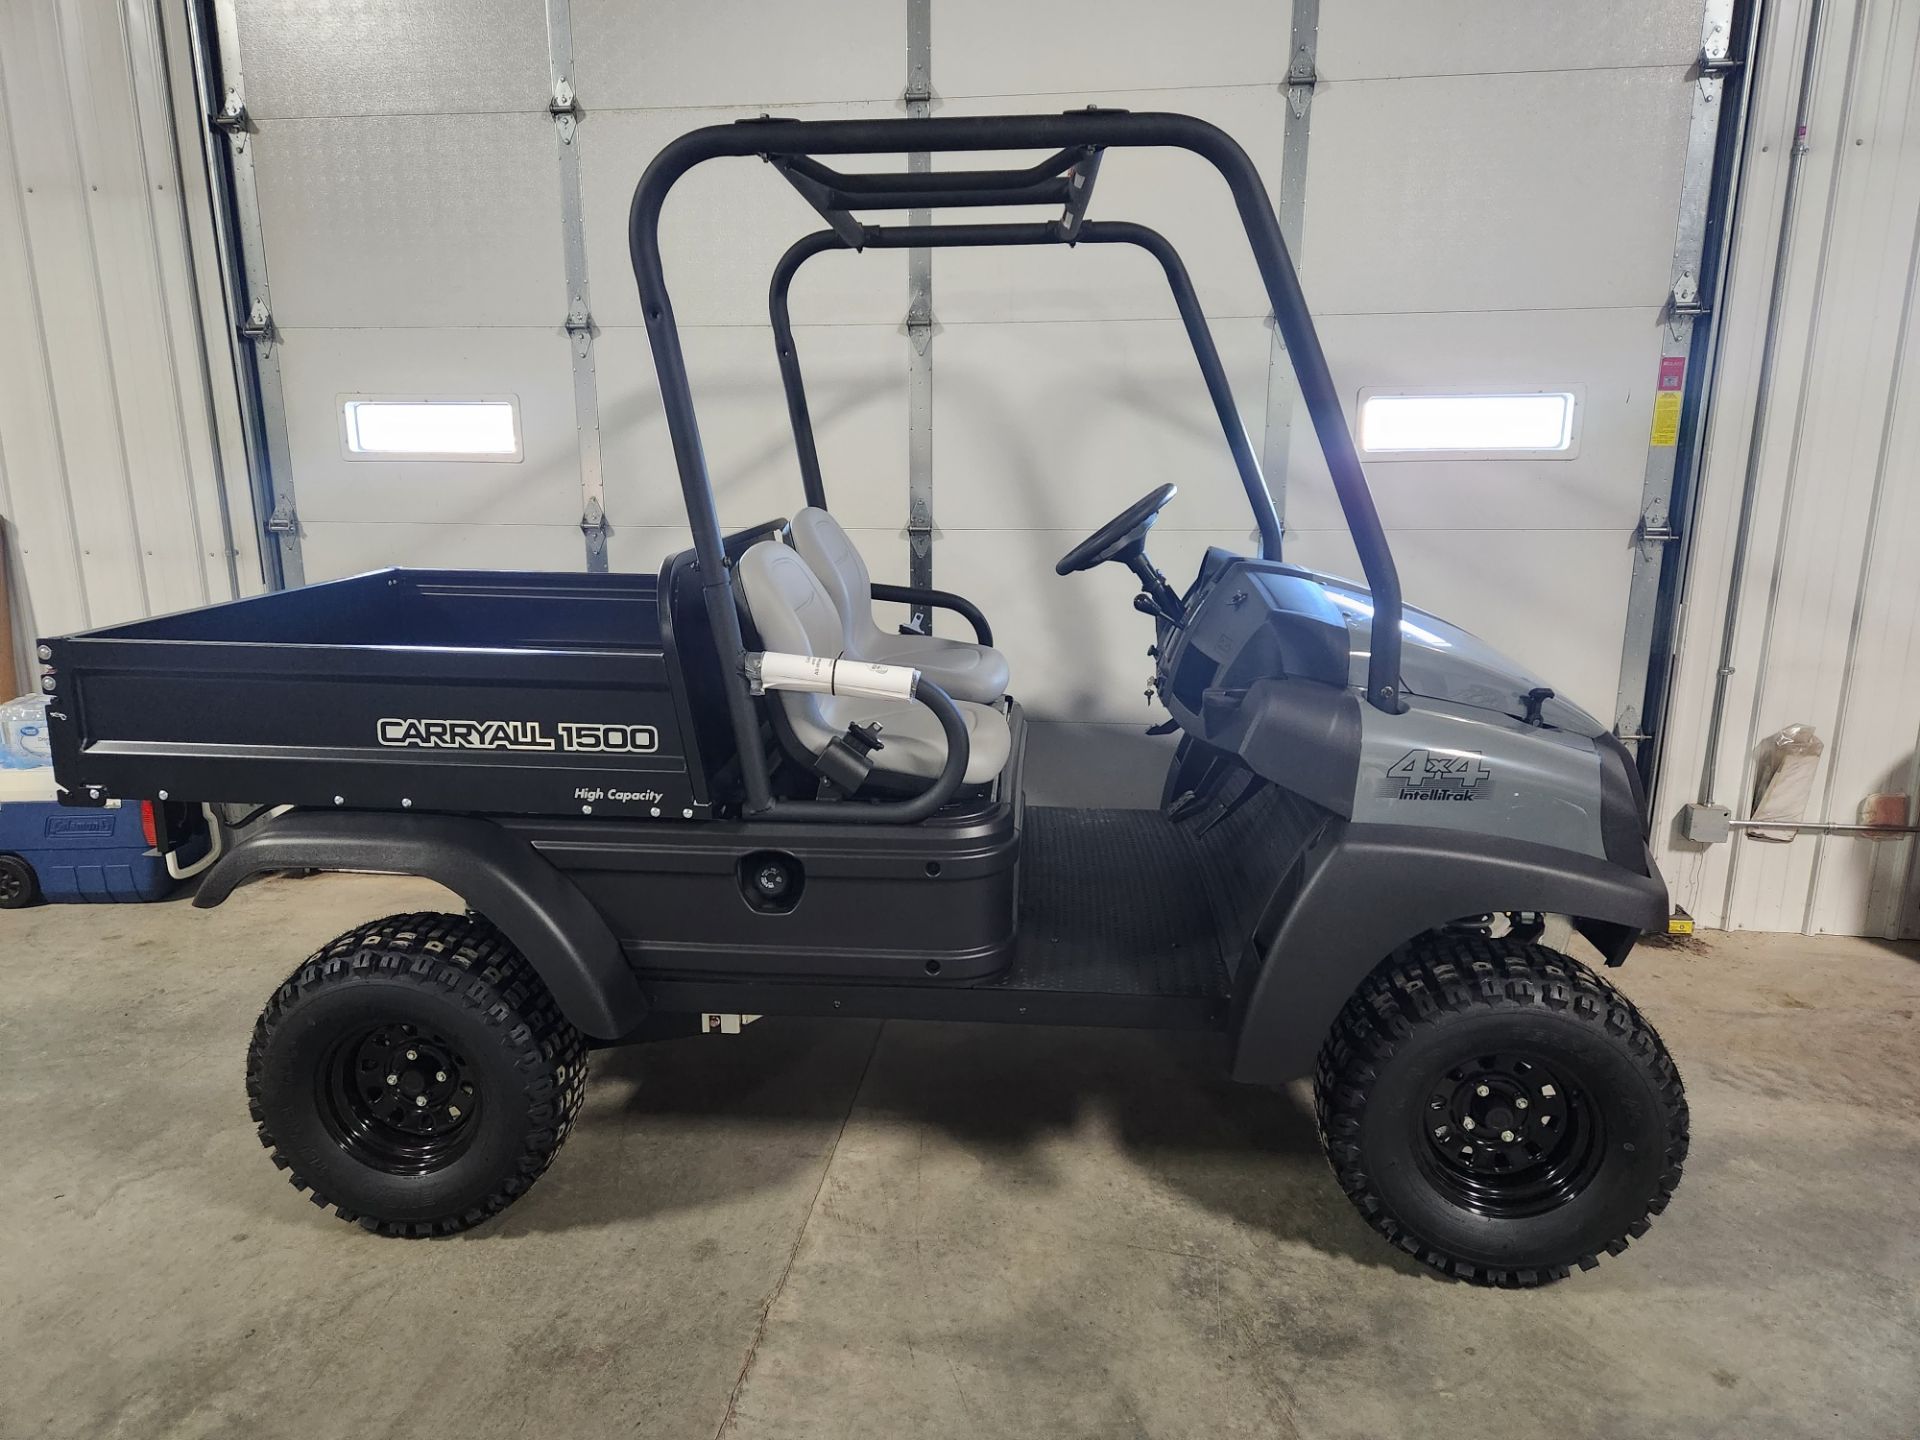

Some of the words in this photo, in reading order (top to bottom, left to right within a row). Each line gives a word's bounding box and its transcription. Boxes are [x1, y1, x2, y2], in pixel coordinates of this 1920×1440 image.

[377, 718, 555, 750] CARRYALL
[558, 723, 659, 752] 1500
[1386, 749, 1490, 787] 4x4
[574, 788, 604, 802] High
[607, 788, 663, 803] Capacity
[1399, 788, 1475, 801] IntelliTrak
